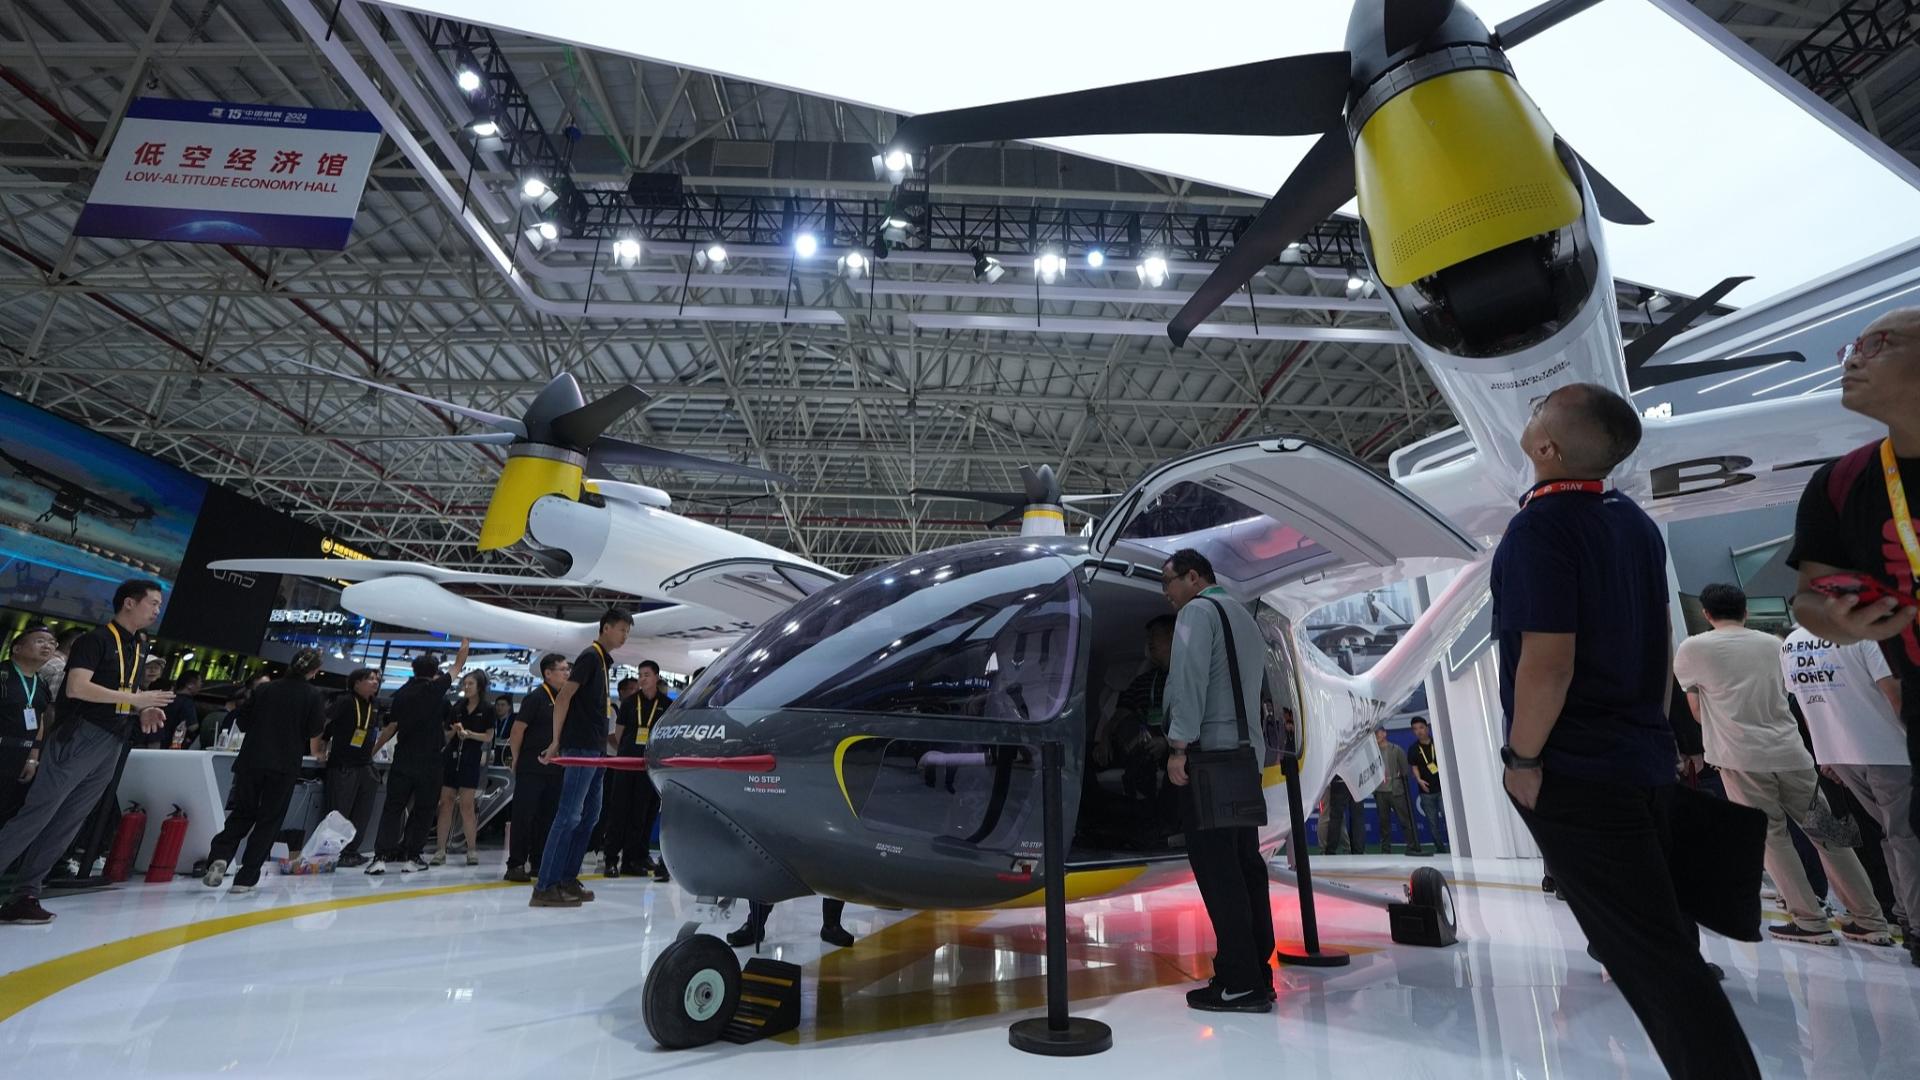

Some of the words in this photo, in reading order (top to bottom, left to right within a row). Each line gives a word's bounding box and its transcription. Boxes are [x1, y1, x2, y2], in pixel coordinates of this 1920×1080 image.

[134, 141, 348, 177] 低空经济馆
[125, 170, 229, 187] LOW-ALTITUDE
[231, 176, 303, 191] ECONOMY
[303, 181, 339, 193] HALL
[1560, 482, 1585, 491] AVIC
[1782, 638, 1841, 654] MR.ENJO
[1797, 655, 1816, 668] DA
[748, 775, 760, 783] NO
[761, 776, 781, 784] STEP
